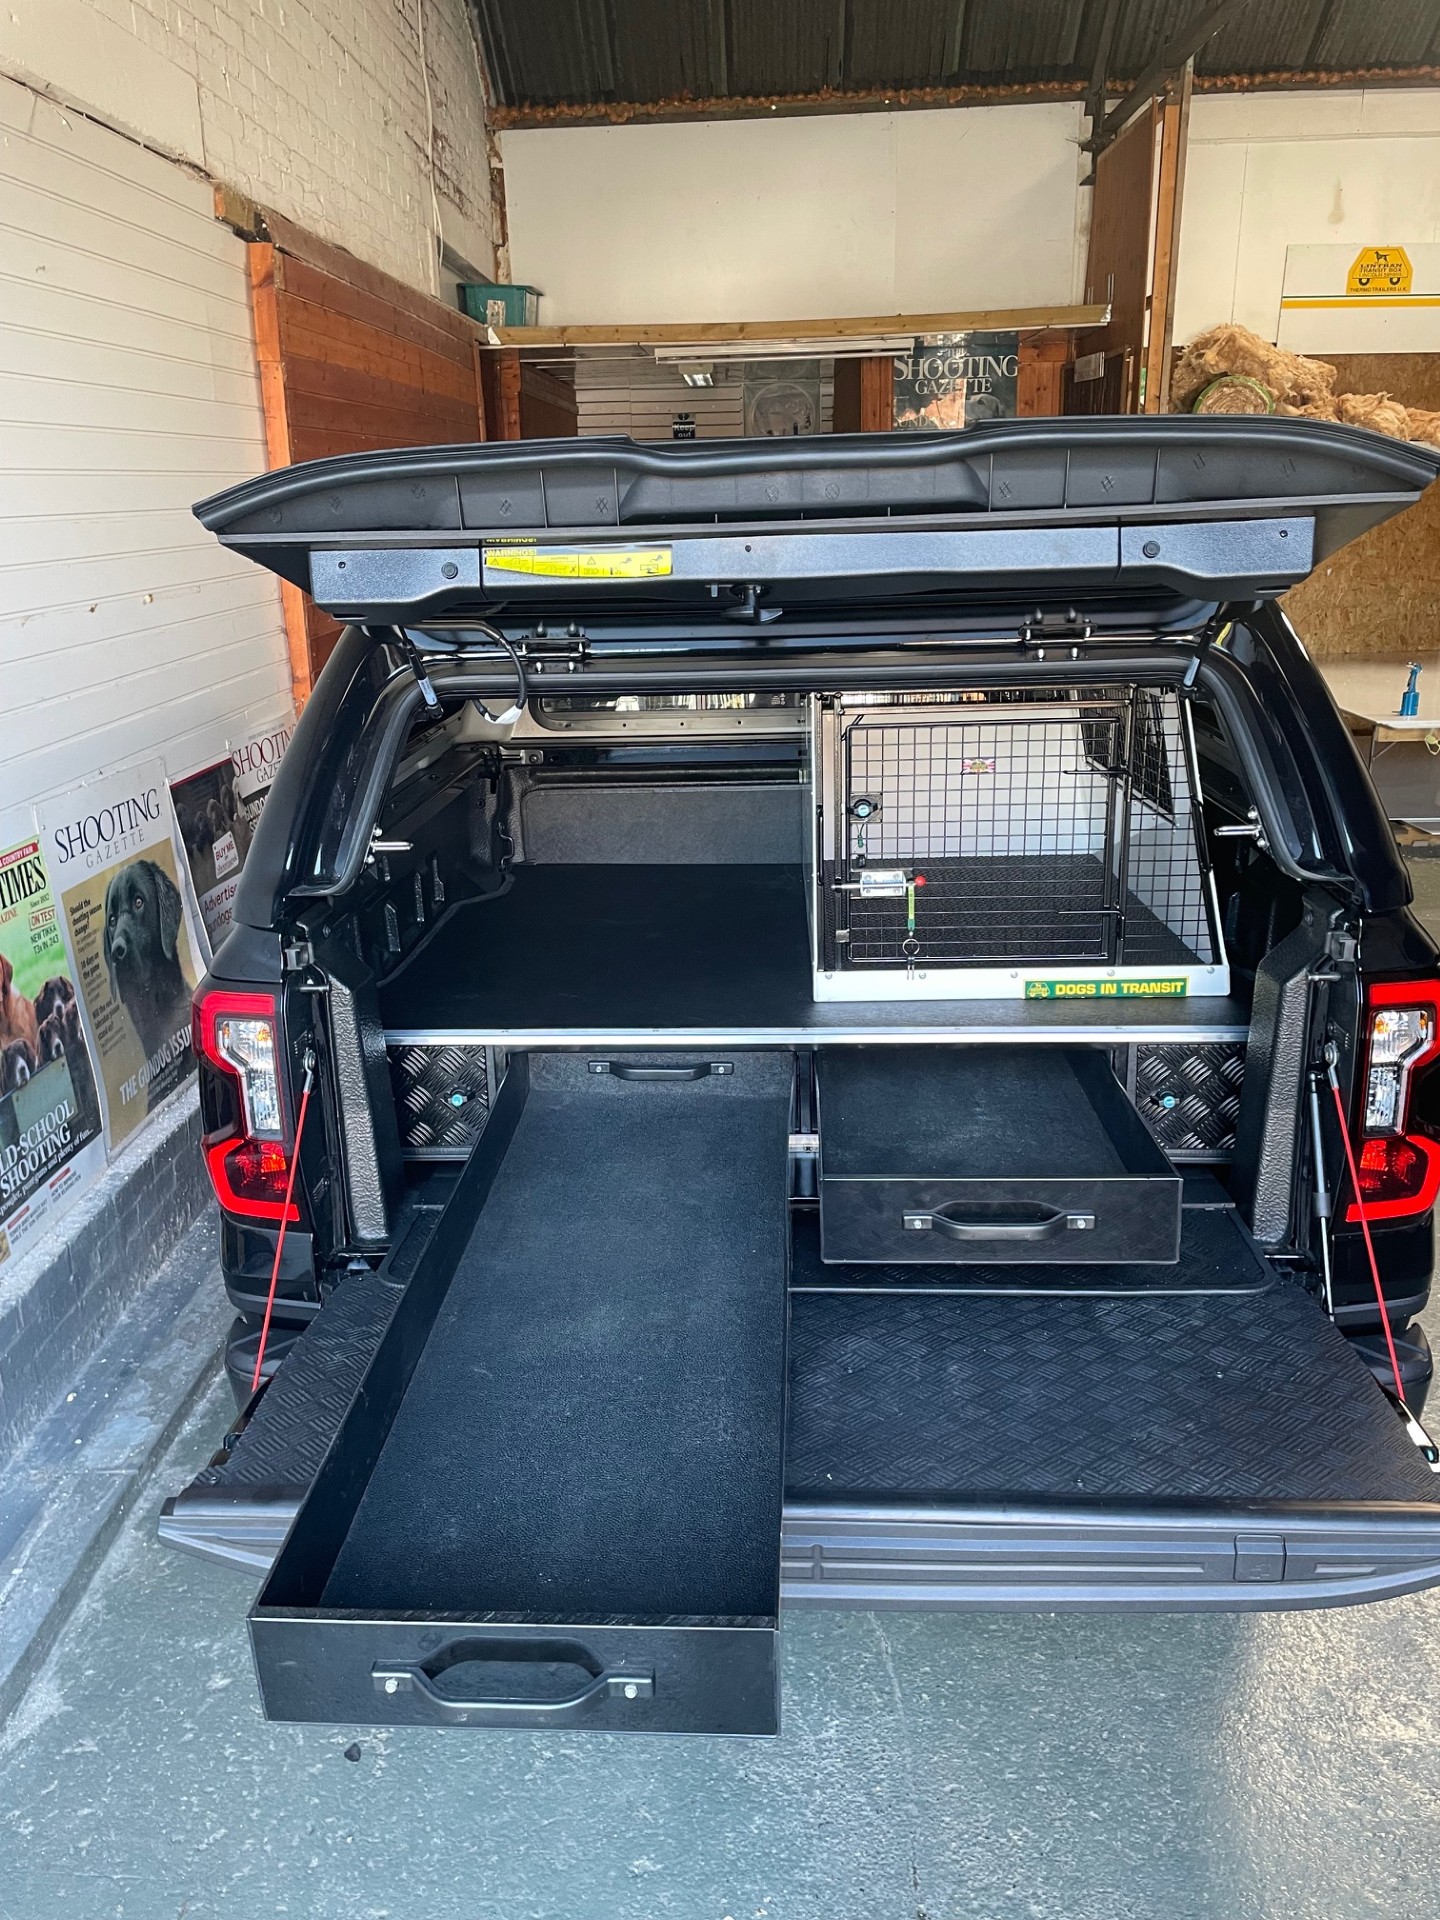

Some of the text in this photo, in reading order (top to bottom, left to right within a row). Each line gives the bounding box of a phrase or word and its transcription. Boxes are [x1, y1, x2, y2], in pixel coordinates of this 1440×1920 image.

[893, 354, 1019, 380] SHOOTING
[915, 377, 993, 395] GAZETE
[231, 723, 297, 779] SHOOTIN
[54, 788, 160, 864] SHOOTING
[1, 850, 24, 867] COUNTRY
[22, 845, 34, 858] FAIR
[85, 828, 145, 869] GAZETTE
[215, 840, 235, 861] BUY ME
[0, 855, 47, 910] TIMES
[31, 908, 56, 927] ON TEST
[69, 898, 91, 917] Should the
[30, 931, 42, 944] NEW
[1055, 982, 1184, 995] DOGS IN TRANSIT
[119, 1073, 138, 1106] THE
[138, 1042, 172, 1089] GUNDOG
[168, 1023, 193, 1058] ISSU
[0, 1121, 71, 1199] SHOOTING
